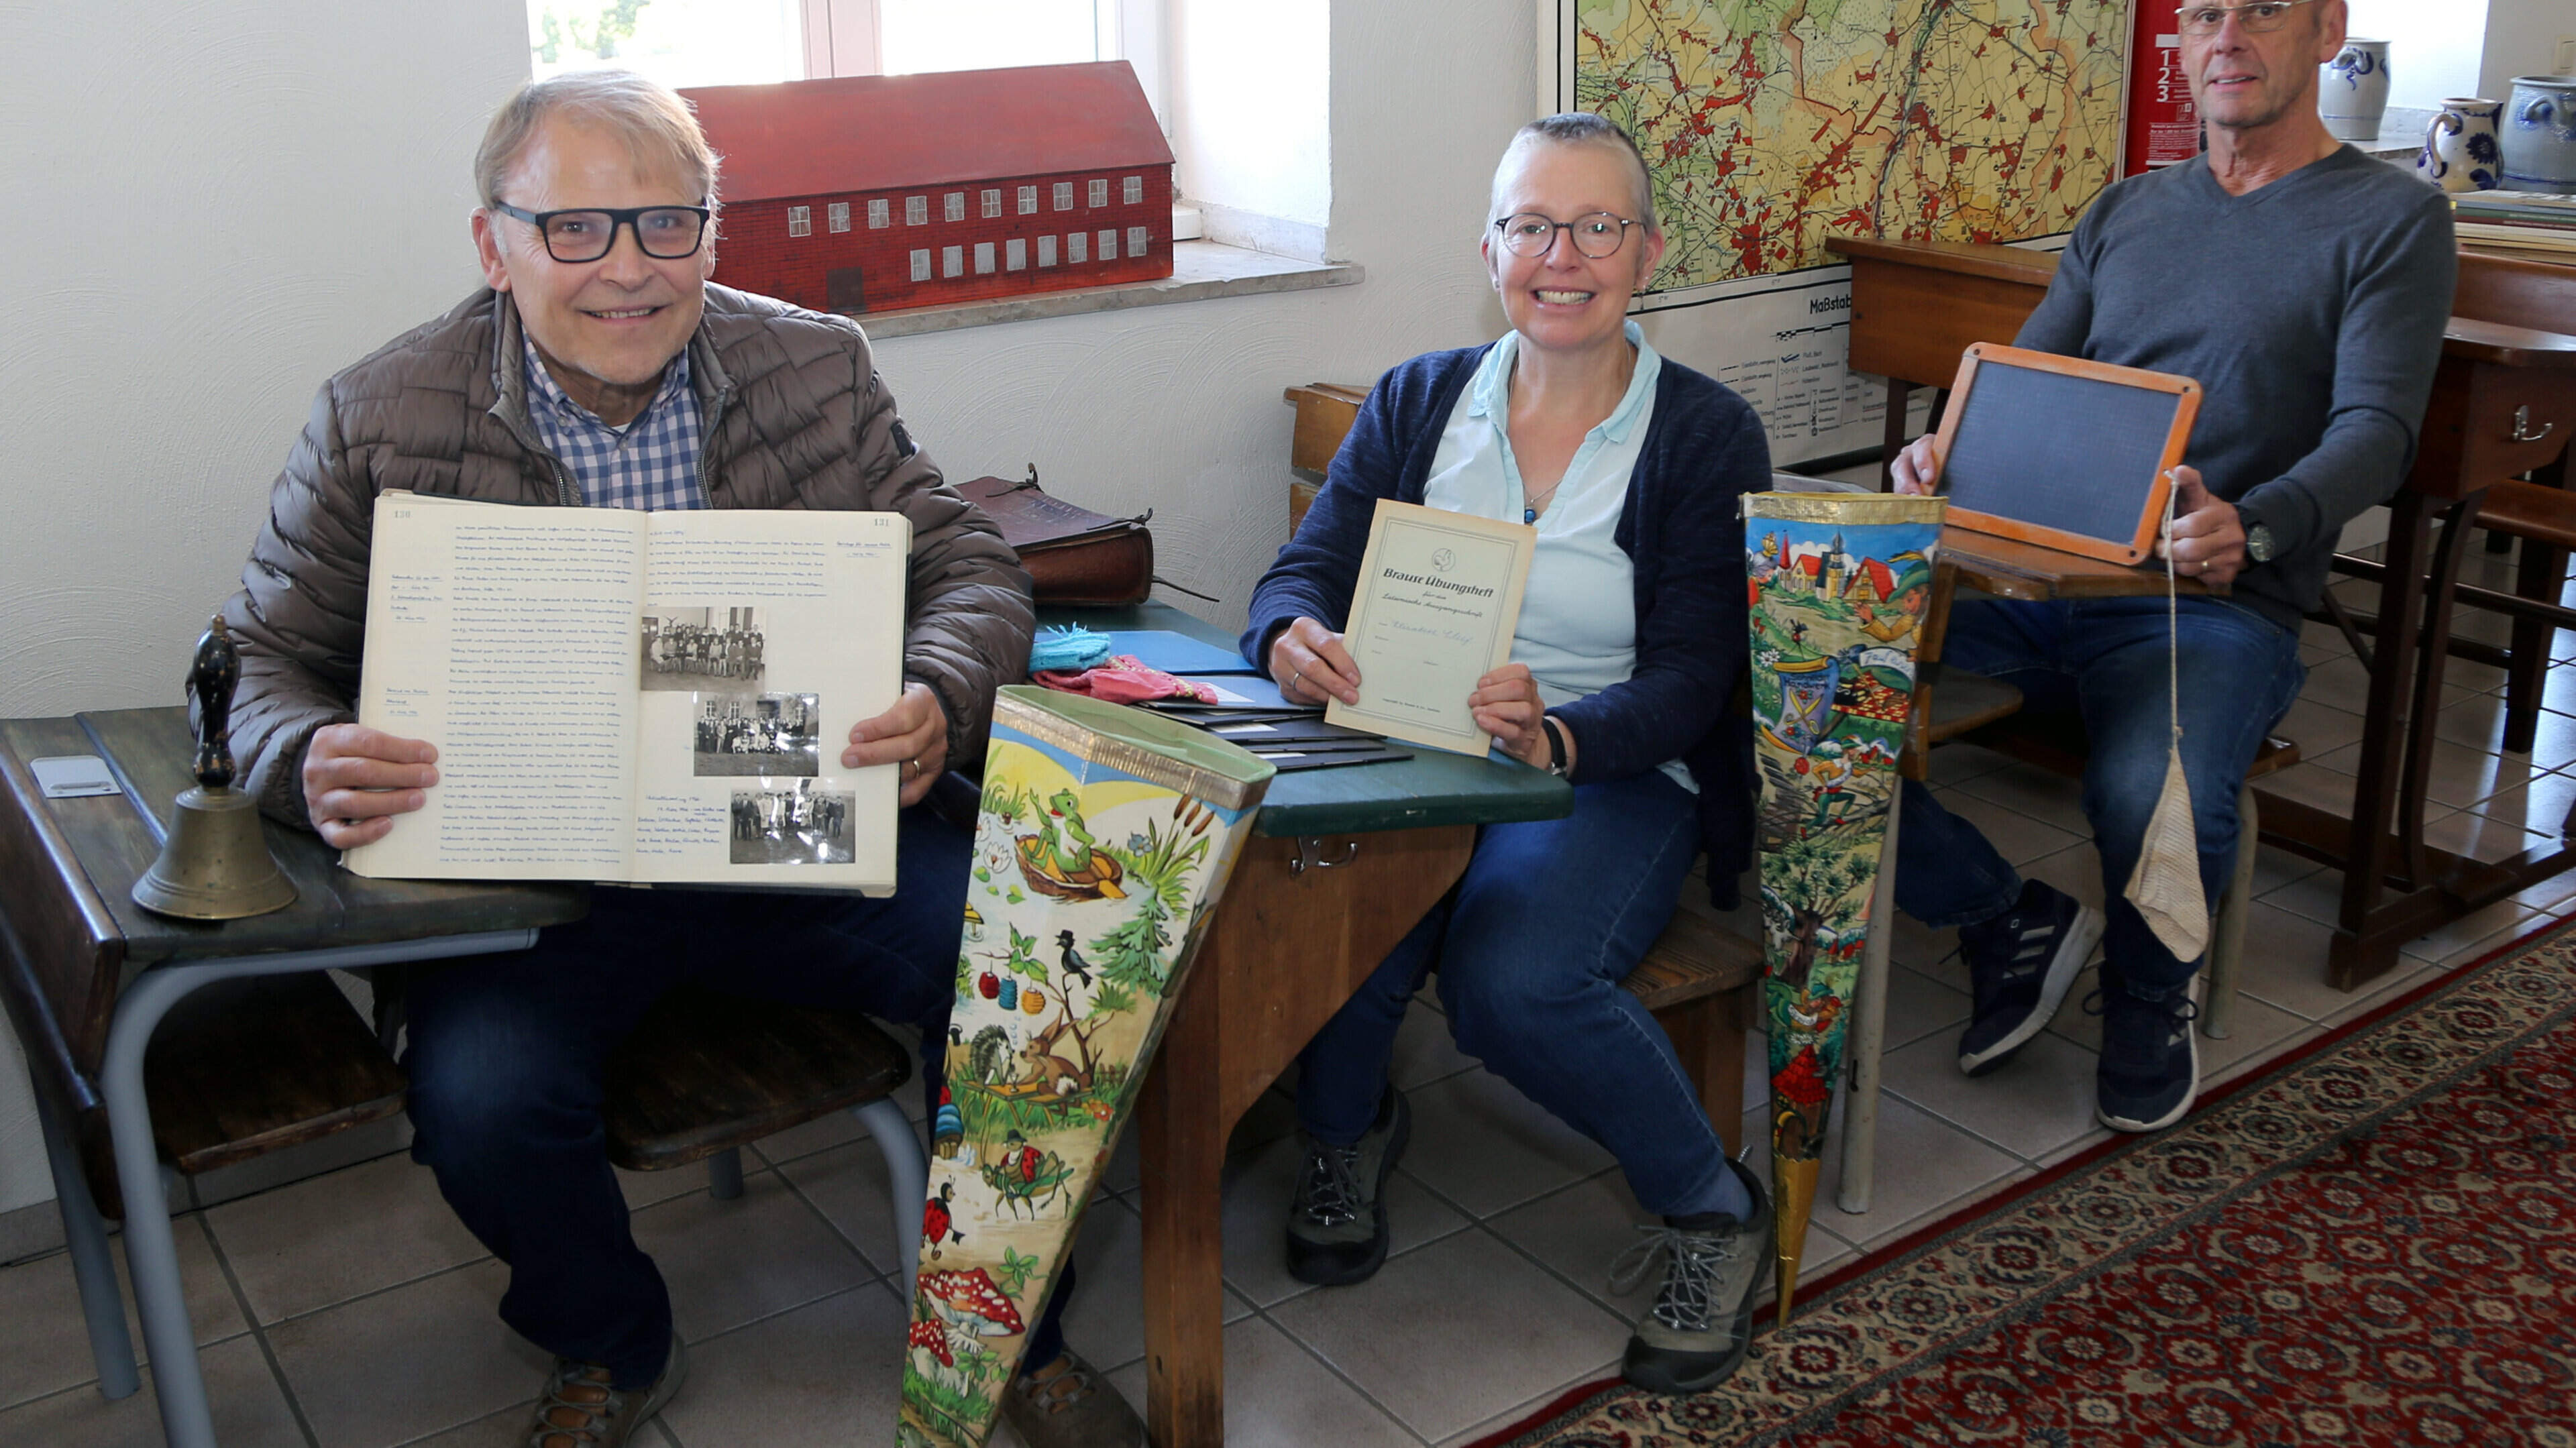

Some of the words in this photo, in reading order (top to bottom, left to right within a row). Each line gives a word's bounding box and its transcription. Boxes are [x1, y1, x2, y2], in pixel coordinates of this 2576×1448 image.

[2161, 49, 2169, 66] 1
[2157, 67, 2170, 85] 2
[2156, 85, 2169, 103] 3
[1383, 567, 1425, 583] Brause
[1425, 575, 1494, 598] Übungsheft
